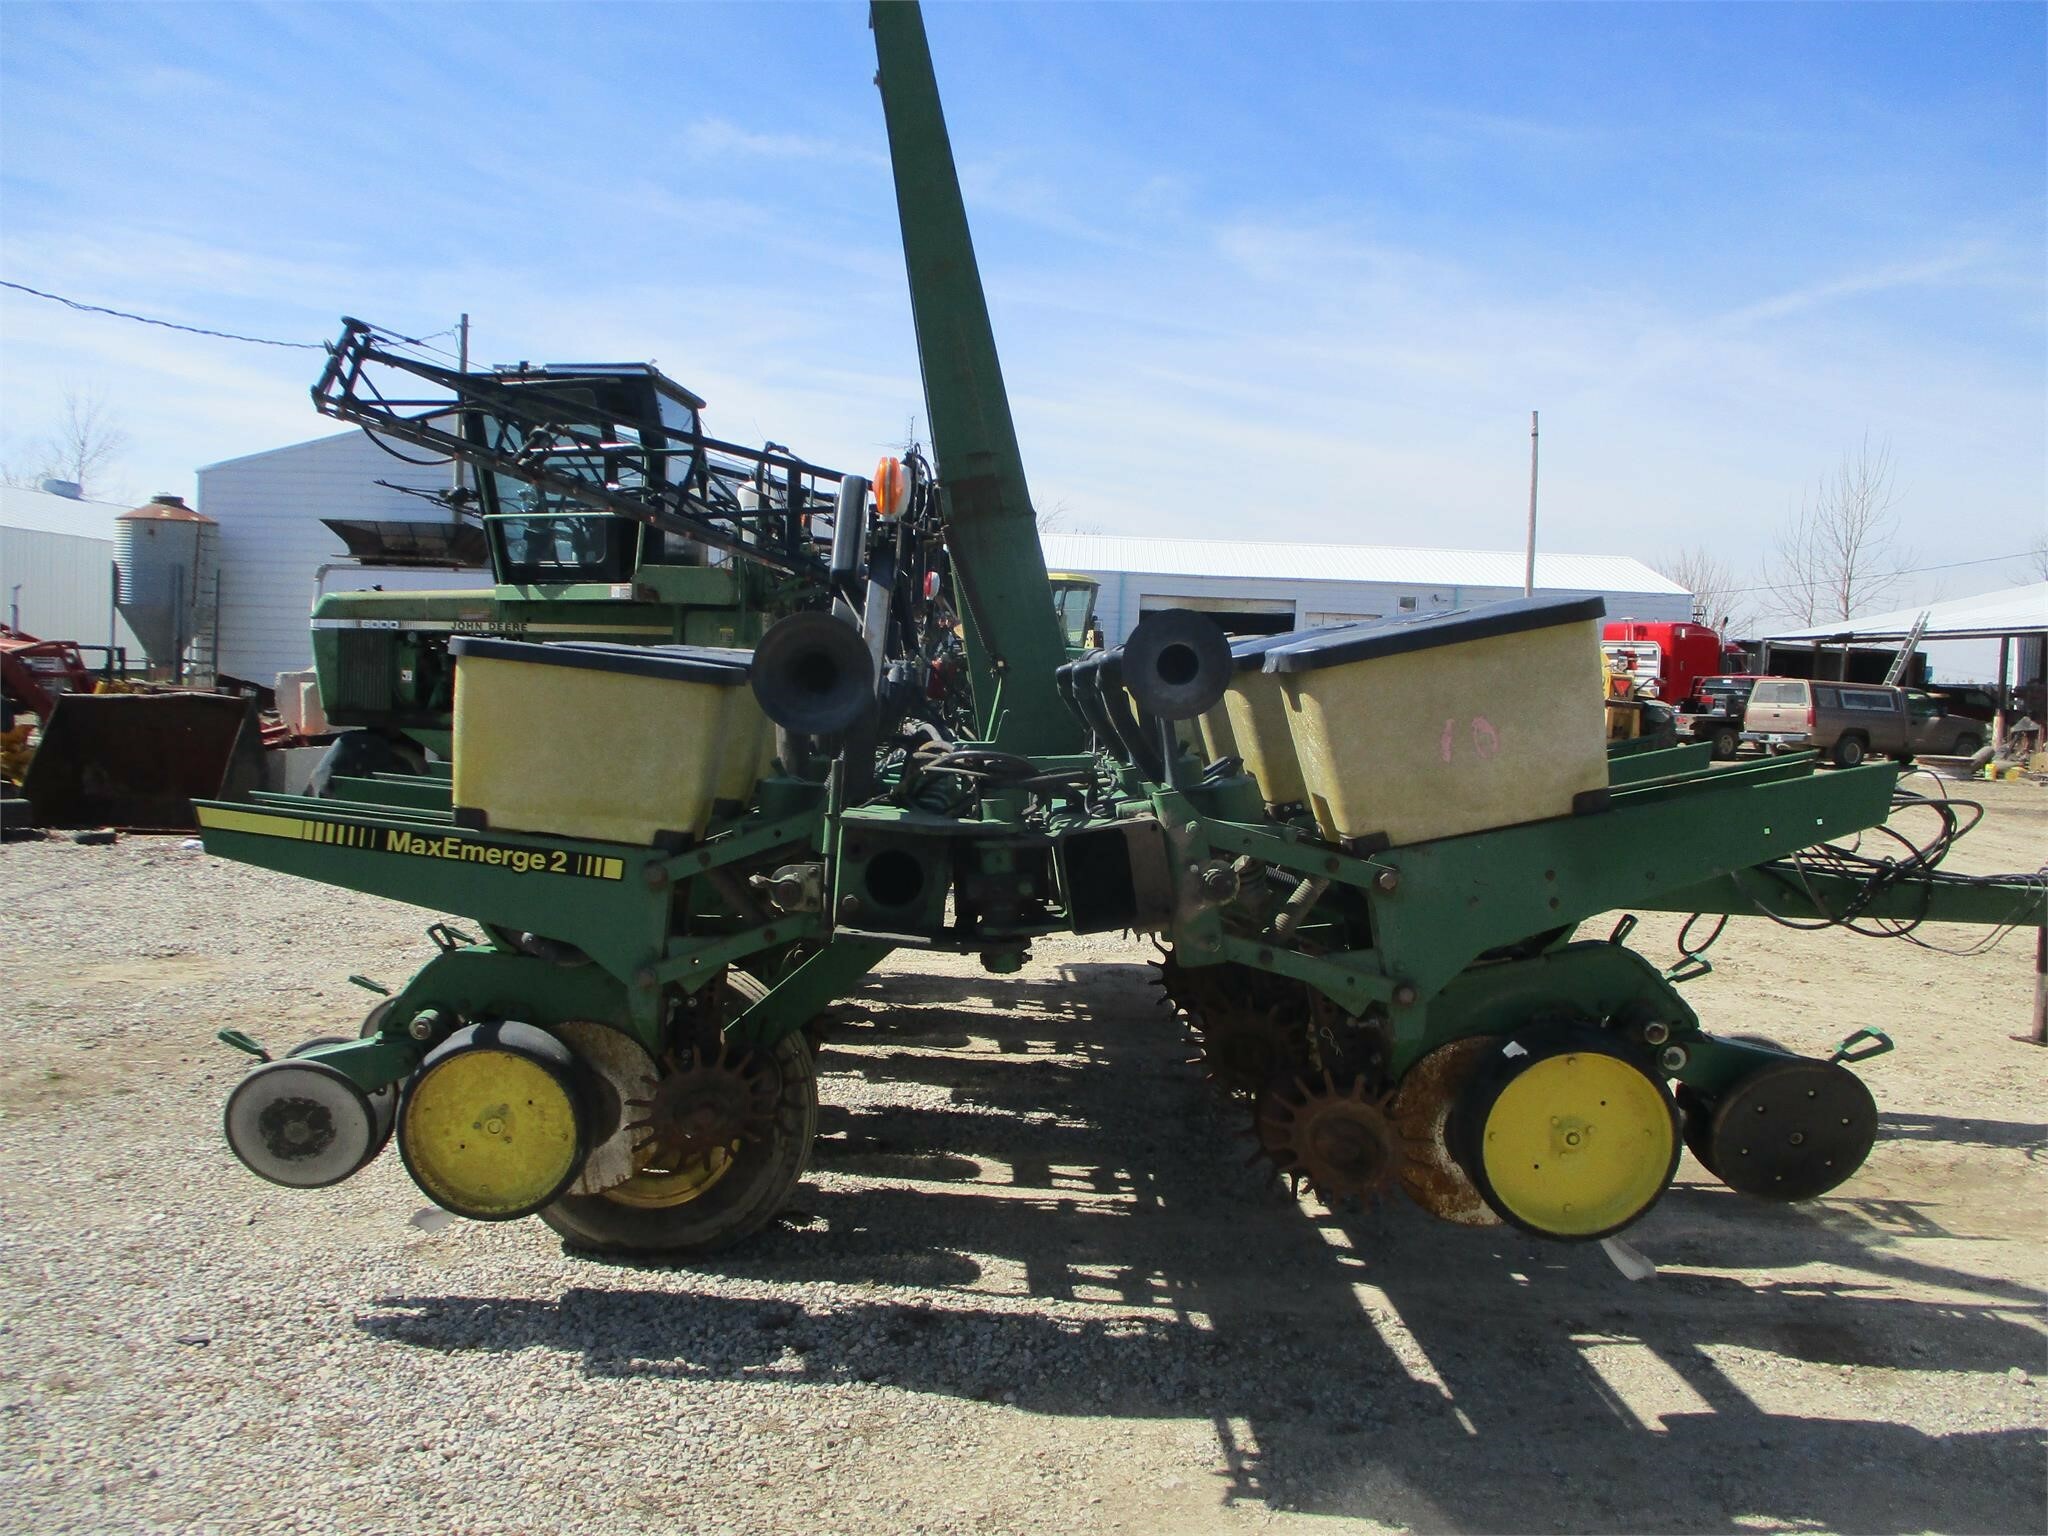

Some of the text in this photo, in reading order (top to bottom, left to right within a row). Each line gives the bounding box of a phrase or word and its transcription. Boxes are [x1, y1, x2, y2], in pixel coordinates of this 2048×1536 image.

[450, 621, 528, 631] JOHN DEERE
[387, 830, 567, 873] MaxEmerge 2
